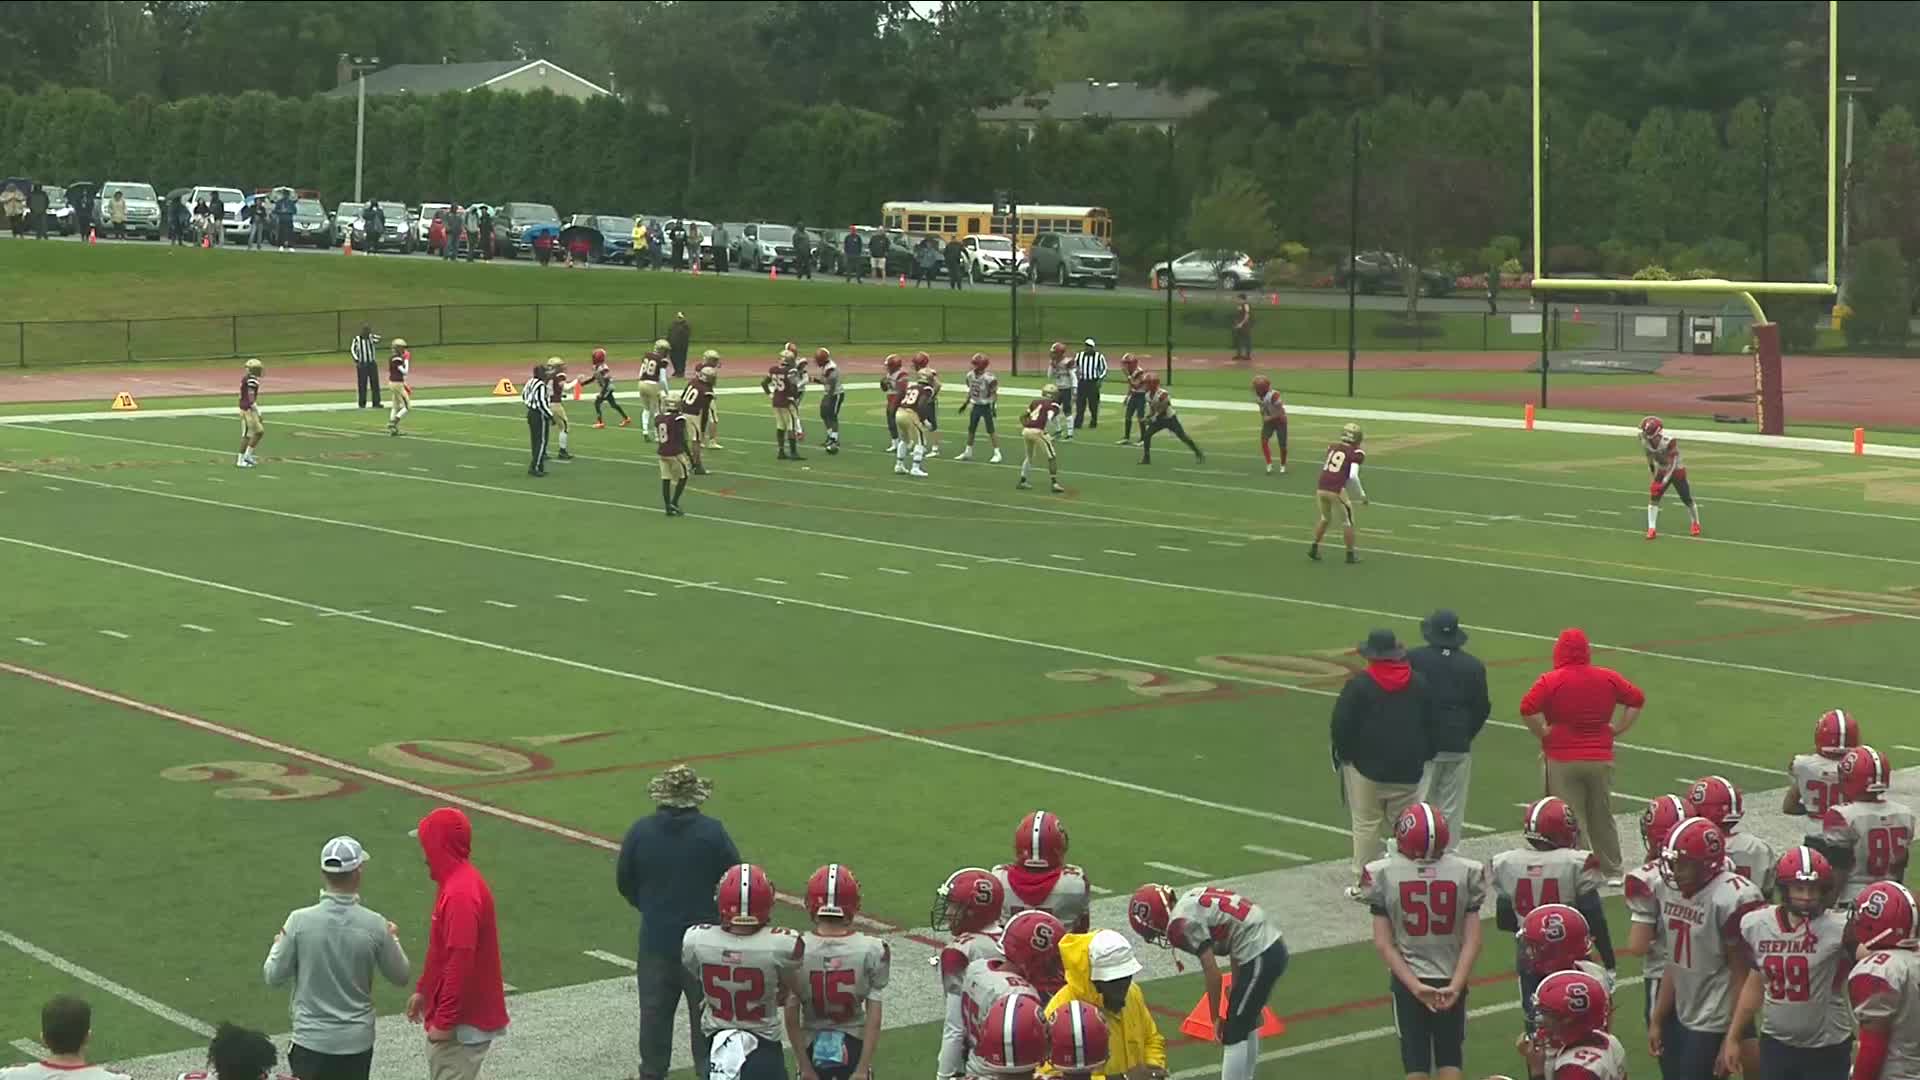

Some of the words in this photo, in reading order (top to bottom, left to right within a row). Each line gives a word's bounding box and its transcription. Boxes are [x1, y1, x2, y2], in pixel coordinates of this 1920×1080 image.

[120, 395, 132, 407] 10
[503, 382, 512, 393] G
[682, 385, 698, 405] 10
[1324, 450, 1345, 472] 19
[1868, 826, 1909, 877] 85
[972, 879, 993, 905] S
[1859, 889, 1888, 919] S
[1399, 879, 1458, 937] 59
[1030, 922, 1053, 952] S
[1541, 912, 1566, 942] S
[1668, 918, 1692, 969] 71
[702, 963, 765, 1022] 52
[809, 968, 856, 1024] 15
[1564, 982, 1590, 1012] S
